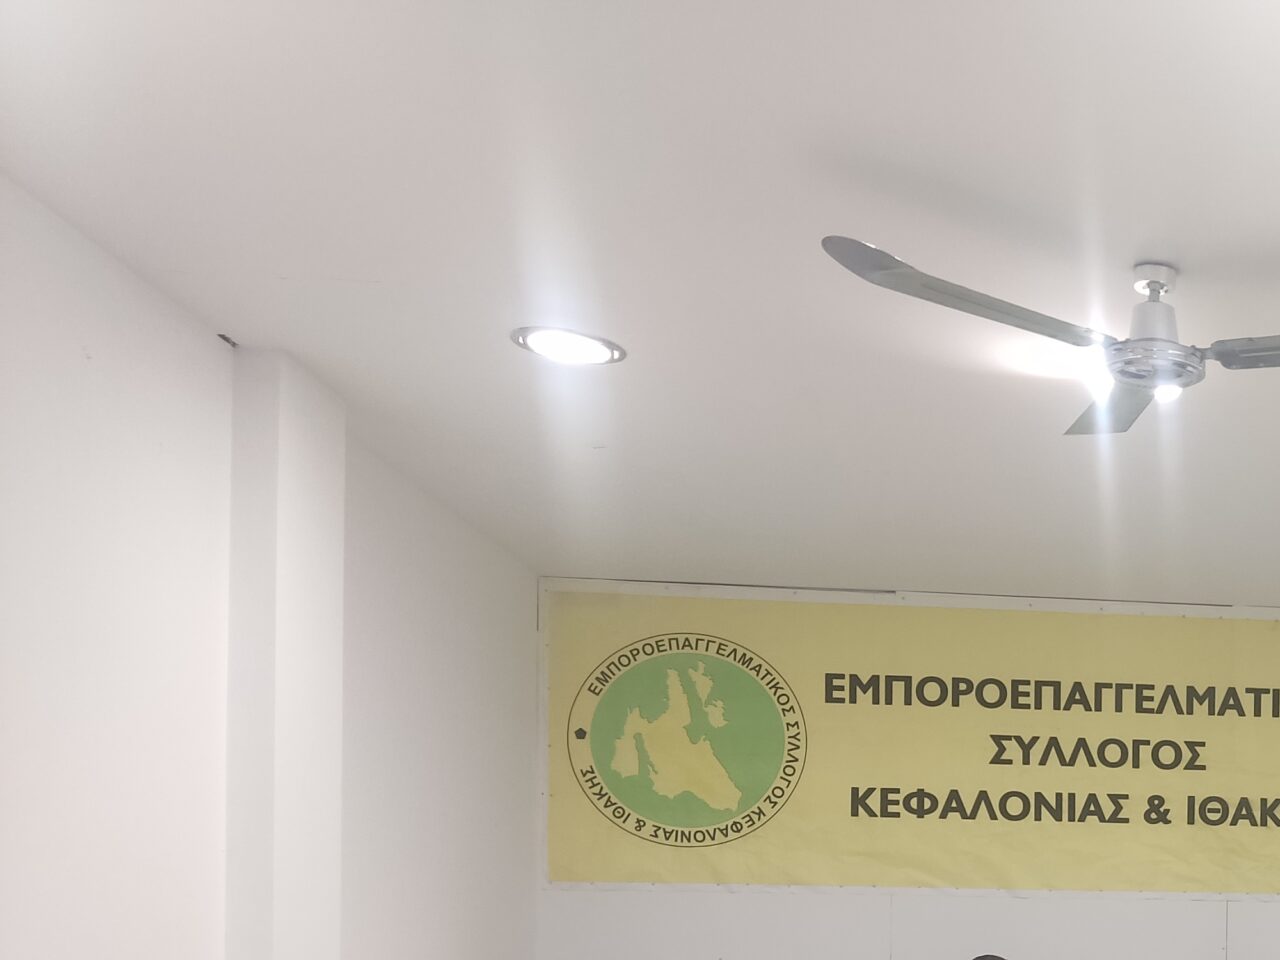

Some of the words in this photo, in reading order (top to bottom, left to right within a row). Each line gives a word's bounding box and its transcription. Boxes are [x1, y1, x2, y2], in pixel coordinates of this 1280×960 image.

[587, 637, 796, 717] ΕΜΠΟΡΟΕΠΑΓΓΕΛΜΑΤΙΚΟΣ
[763, 719, 801, 810] ΣΥΛΛΟΓΟΣ
[988, 734, 1208, 771] ΣΥΛΛΟΓΟΣ
[580, 764, 632, 825] ΙΘΑΚΗΣ
[850, 786, 1130, 824] ΚΕΦΑΛΟΝΙΑΣ
[1143, 794, 1172, 825] &
[634, 817, 647, 832] &
[649, 805, 767, 844] ΚΕΦΑΛΟΝΙΑΣ
